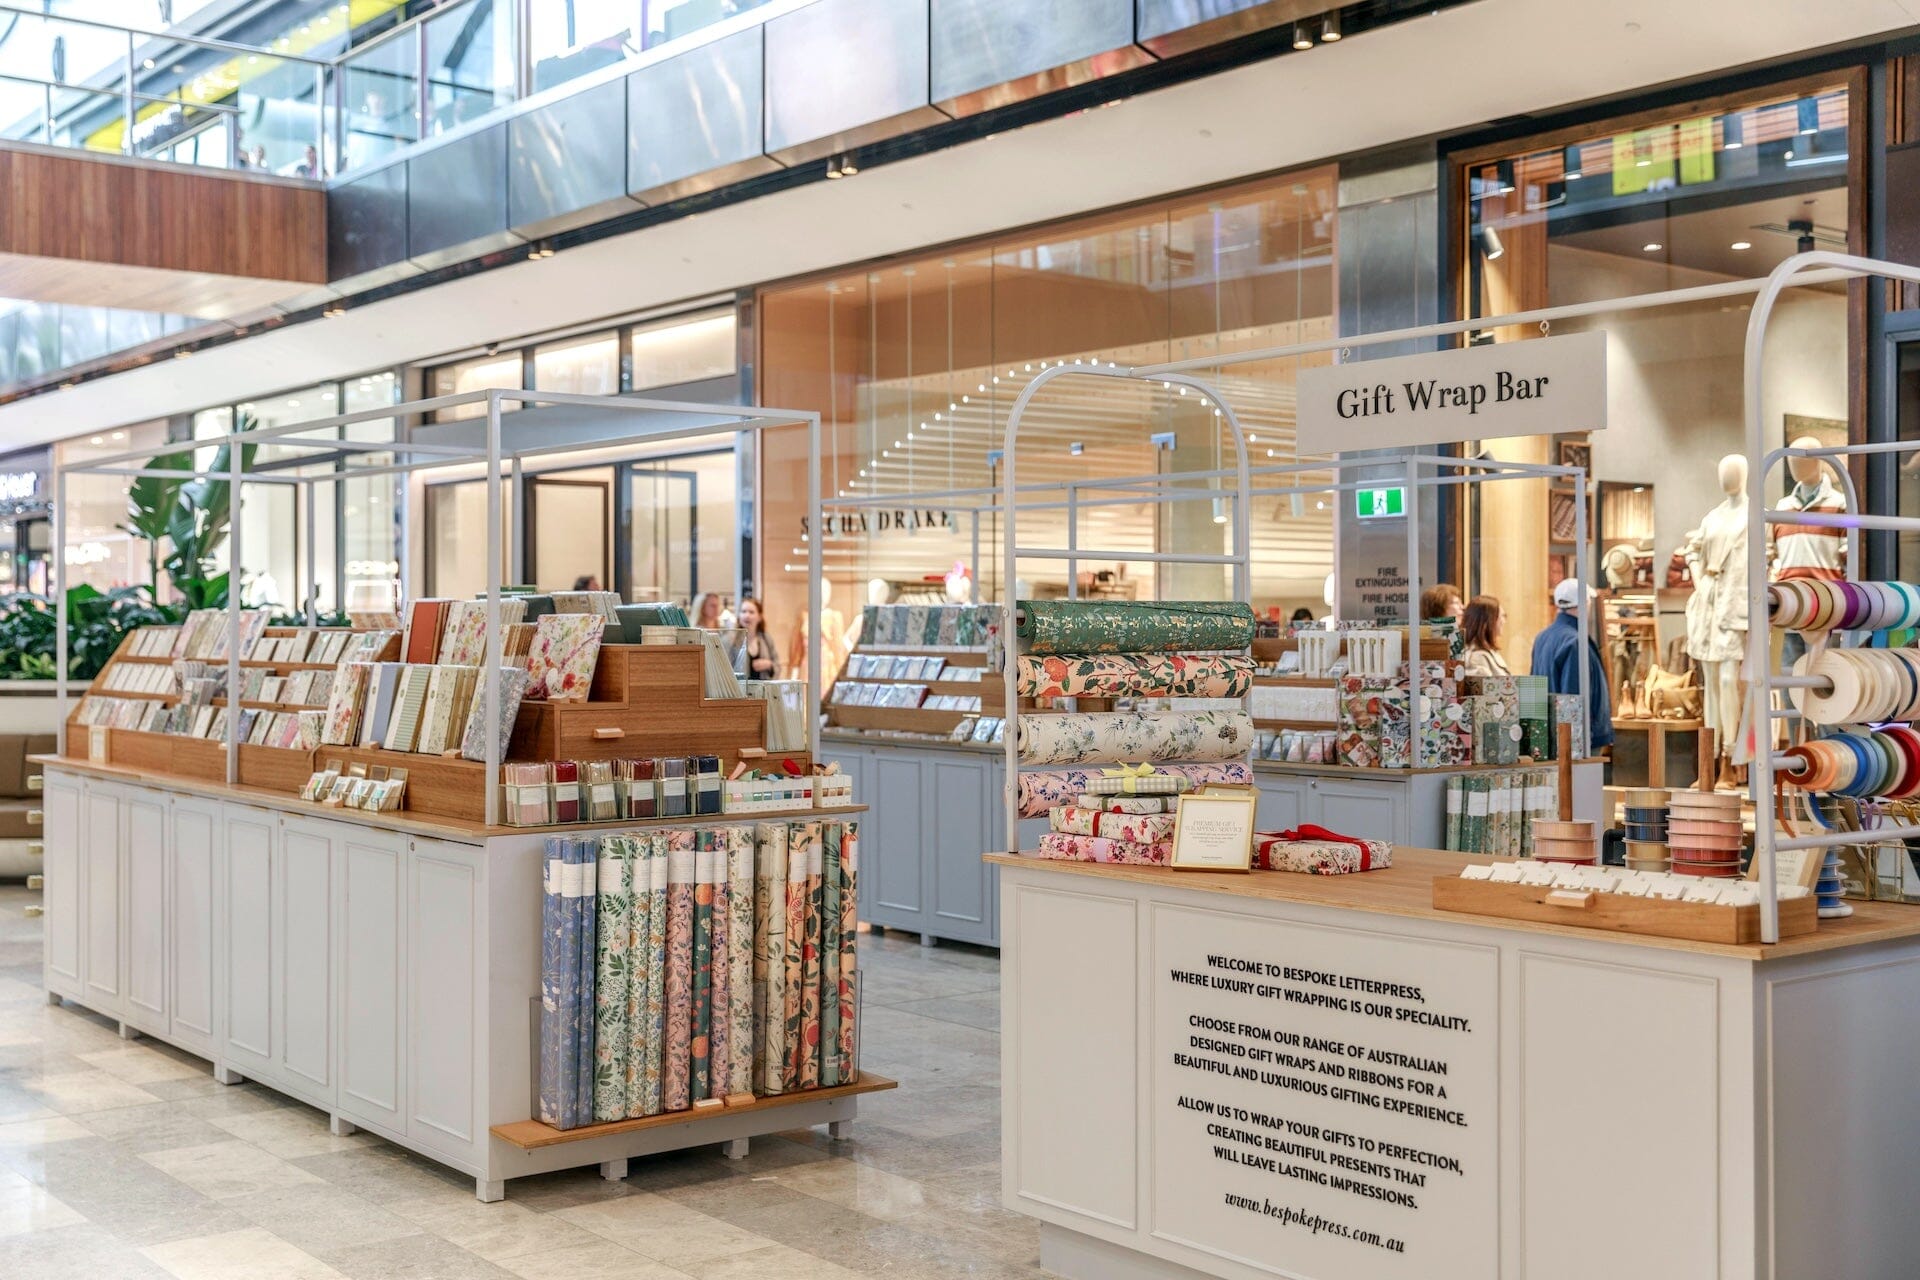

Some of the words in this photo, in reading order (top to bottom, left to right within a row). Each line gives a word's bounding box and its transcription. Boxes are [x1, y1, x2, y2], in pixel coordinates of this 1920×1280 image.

[1336, 384, 1395, 419] Gift
[1403, 379, 1486, 414] Wrap
[1495, 371, 1549, 402] Bar
[1362, 594, 1383, 604] FIRE
[1377, 567, 1398, 576] FIRE
[1374, 606, 1399, 616] REEL
[1170, 969, 1209, 987] WHERE
[1211, 976, 1255, 995] LUXURY
[1256, 984, 1282, 1000] GIFT
[1283, 988, 1348, 1012] WRAPPING
[1350, 999, 1362, 1014] IS
[1364, 1002, 1393, 1019] OUR
[1395, 1007, 1472, 1033] SPECIALITY.
[1206, 954, 1263, 975] WELCOME
[1264, 963, 1281, 978] TO
[1283, 966, 1337, 987] BESPOKE
[1339, 975, 1425, 1005] LETTERPRESS,
[1188, 1014, 1236, 1035] CHOOSE
[1238, 1023, 1272, 1042] FROM
[1273, 1031, 1301, 1047] OUR
[1302, 1035, 1345, 1056] RANGE
[1346, 1044, 1366, 1059] OF
[1366, 1048, 1448, 1076] AUSTRALIAN
[1190, 1035, 1246, 1057] DESIGNED
[1247, 1047, 1273, 1064] GIFT
[1274, 1052, 1316, 1072] WRAPS
[1317, 1061, 1346, 1078] AND
[1348, 1067, 1405, 1090] RIBBONS
[1407, 1078, 1435, 1097] FOR
[1436, 1085, 1448, 1100] A
[1173, 1052, 1232, 1077] BEAUTIFUL
[1232, 1065, 1259, 1082] AND
[1260, 1071, 1328, 1097] LUXURIOUS
[1330, 1086, 1381, 1108] GIFTING
[1383, 1097, 1468, 1128] EXPERIENCE.
[1176, 1095, 1215, 1115] ALLOW
[1216, 1103, 1232, 1119] US
[1232, 1107, 1249, 1122] TO
[1250, 1111, 1284, 1131] WRAP
[1285, 1119, 1320, 1140] YOUR
[1321, 1129, 1356, 1148] GIFTS
[1357, 1136, 1376, 1152] TO
[1377, 1141, 1464, 1177] PERFECTION,
[1206, 1123, 1263, 1147] CREATING
[1264, 1136, 1328, 1164] BEAUTIFUL
[1329, 1152, 1392, 1180] PRESENTS
[1393, 1167, 1427, 1188] THAT
[1213, 1145, 1240, 1164] WILL
[1241, 1152, 1276, 1173] LEAVE
[1278, 1161, 1328, 1186] LASTING
[1330, 1175, 1418, 1210] IMPRESSIONS.
[1225, 1193, 1405, 1254] www.bespokepress.com.au
